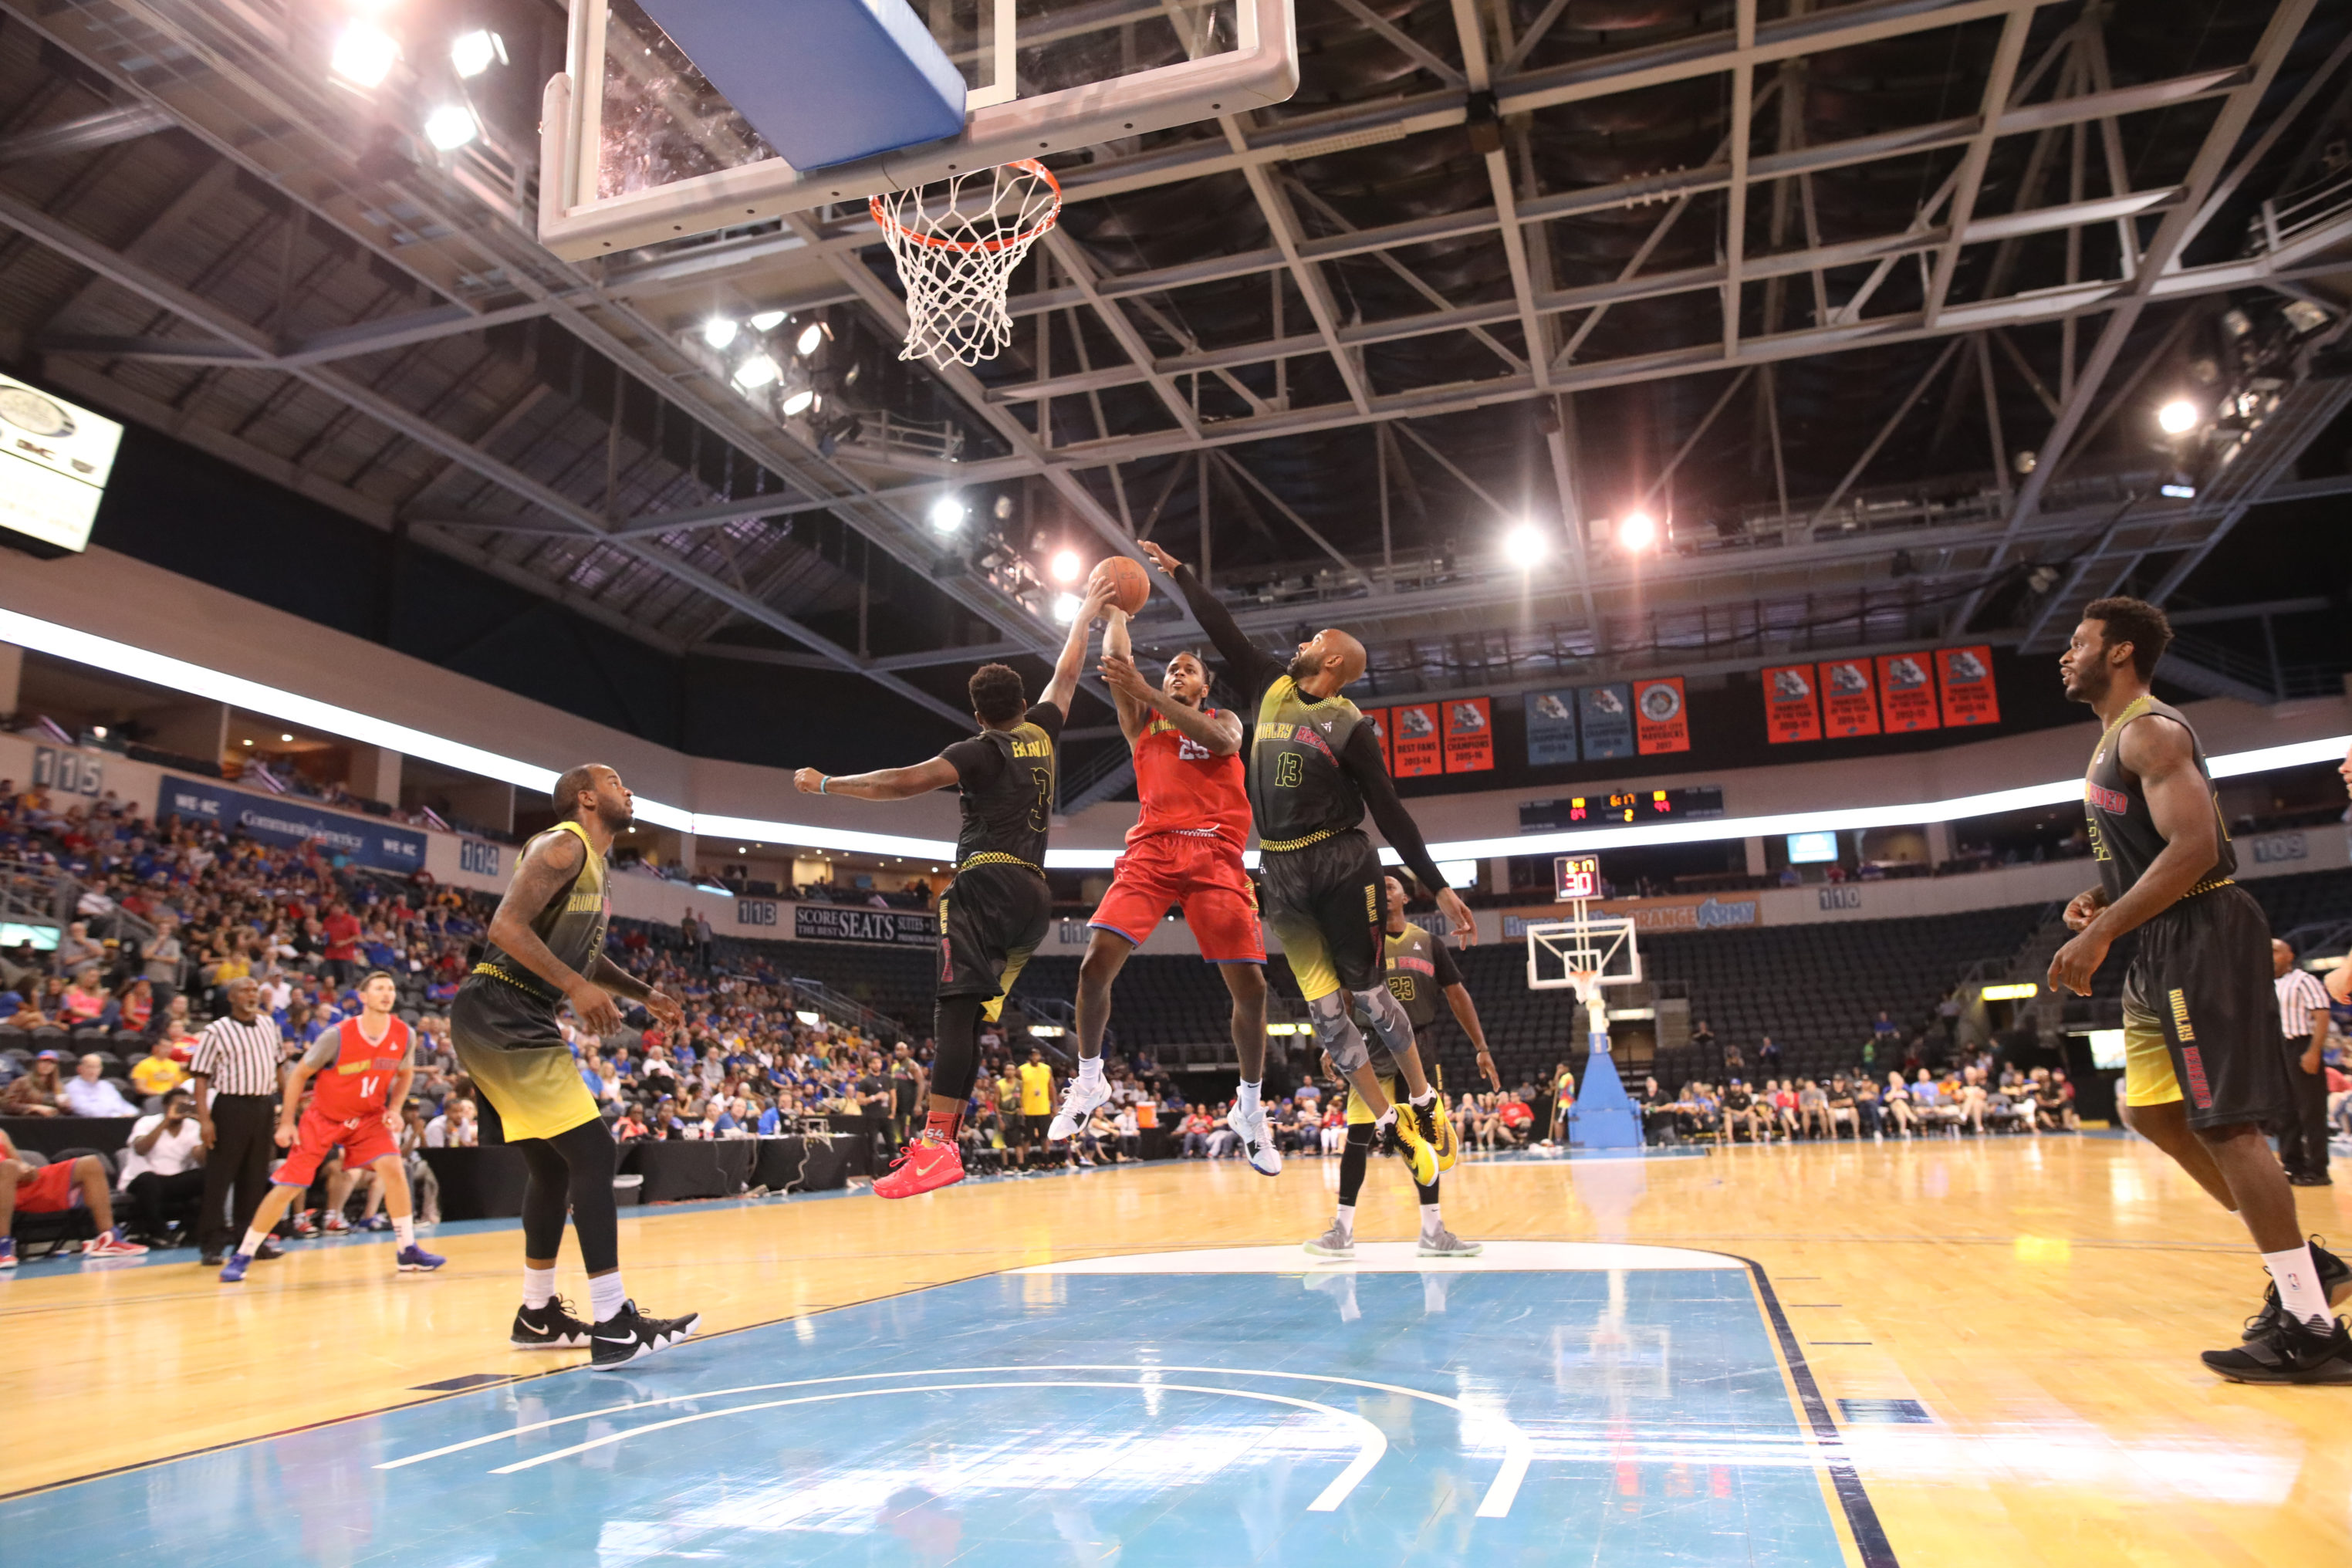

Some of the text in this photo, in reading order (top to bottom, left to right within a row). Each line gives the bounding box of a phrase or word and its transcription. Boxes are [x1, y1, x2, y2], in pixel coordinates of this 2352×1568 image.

[1397, 742, 1436, 753] BEST FANS
[1448, 740, 1489, 751] CHAMPIONS
[39, 752, 100, 793] 115
[1276, 752, 1303, 787] 13
[1610, 793, 1635, 807] 6:17
[1624, 809, 1634, 822] 2
[462, 843, 499, 873] 114
[1364, 883, 1378, 922] RIVALRY
[1821, 889, 1860, 909] 110
[739, 901, 776, 924] 113
[797, 909, 839, 926] SCORE
[897, 916, 924, 932] SUITES
[1698, 897, 1756, 930] ARMY
[798, 926, 838, 936] THE BEST
[839, 911, 894, 941] SEATS
[1389, 975, 1415, 1001] 23
[2168, 988, 2196, 1042] RIVALRY
[2181, 1046, 2212, 1109] RENEWED
[927, 1128, 945, 1139] 54
